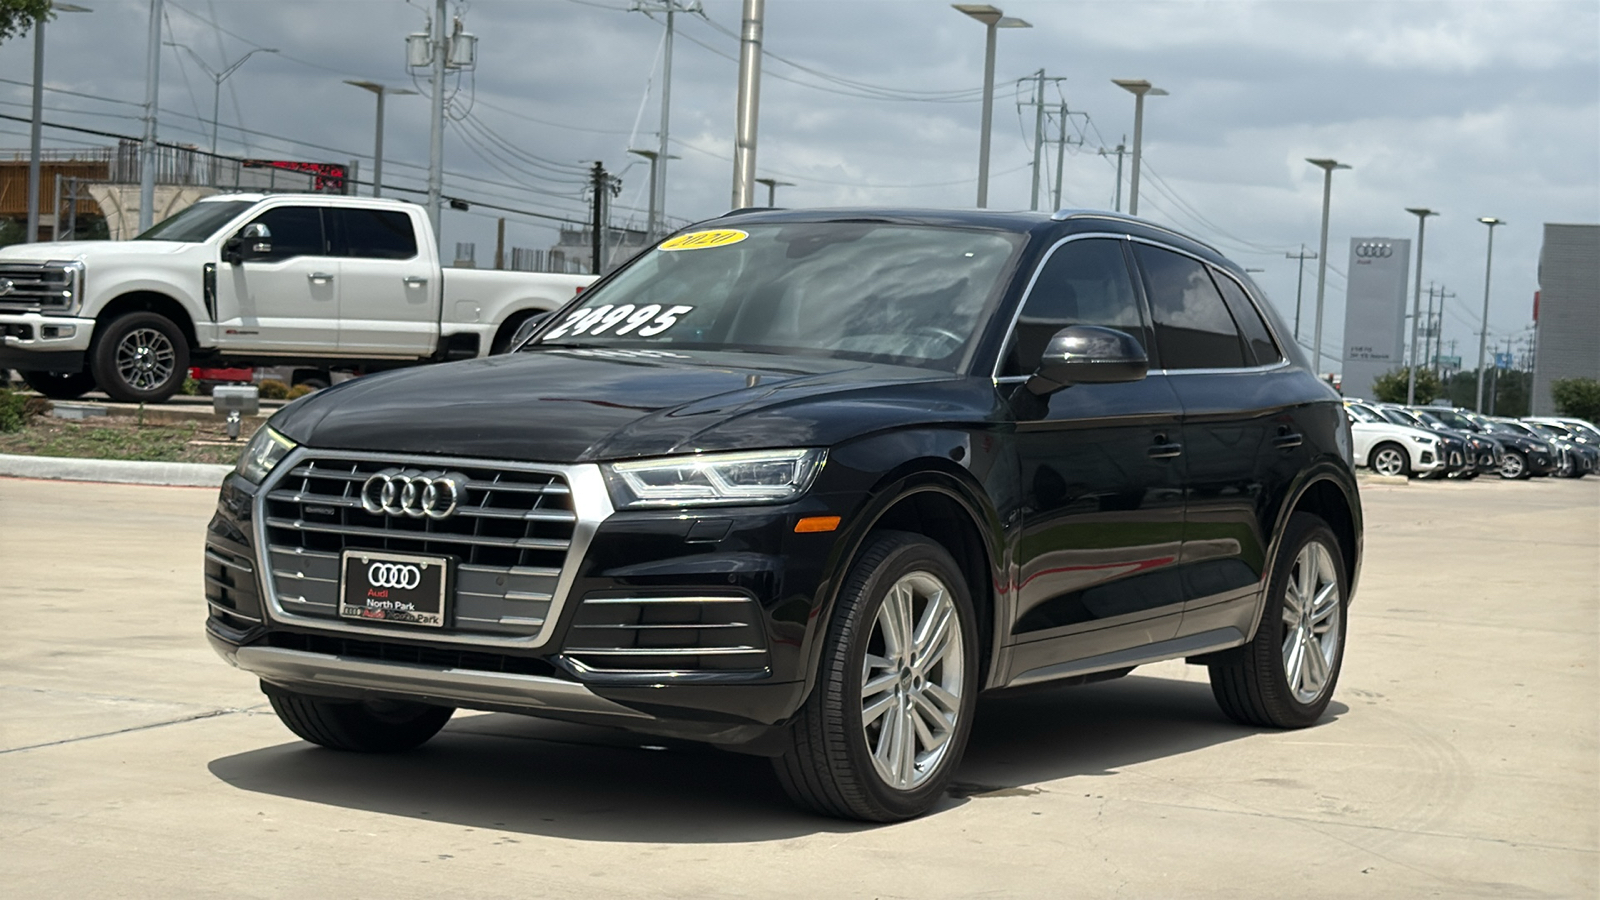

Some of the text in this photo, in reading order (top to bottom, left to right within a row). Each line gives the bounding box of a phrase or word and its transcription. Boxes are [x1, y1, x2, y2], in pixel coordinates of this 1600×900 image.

[667, 232, 738, 248] 2020
[542, 303, 694, 341] 24995
[367, 588, 389, 598] Audi
[366, 598, 416, 611] North Park
[417, 614, 439, 625] Park
